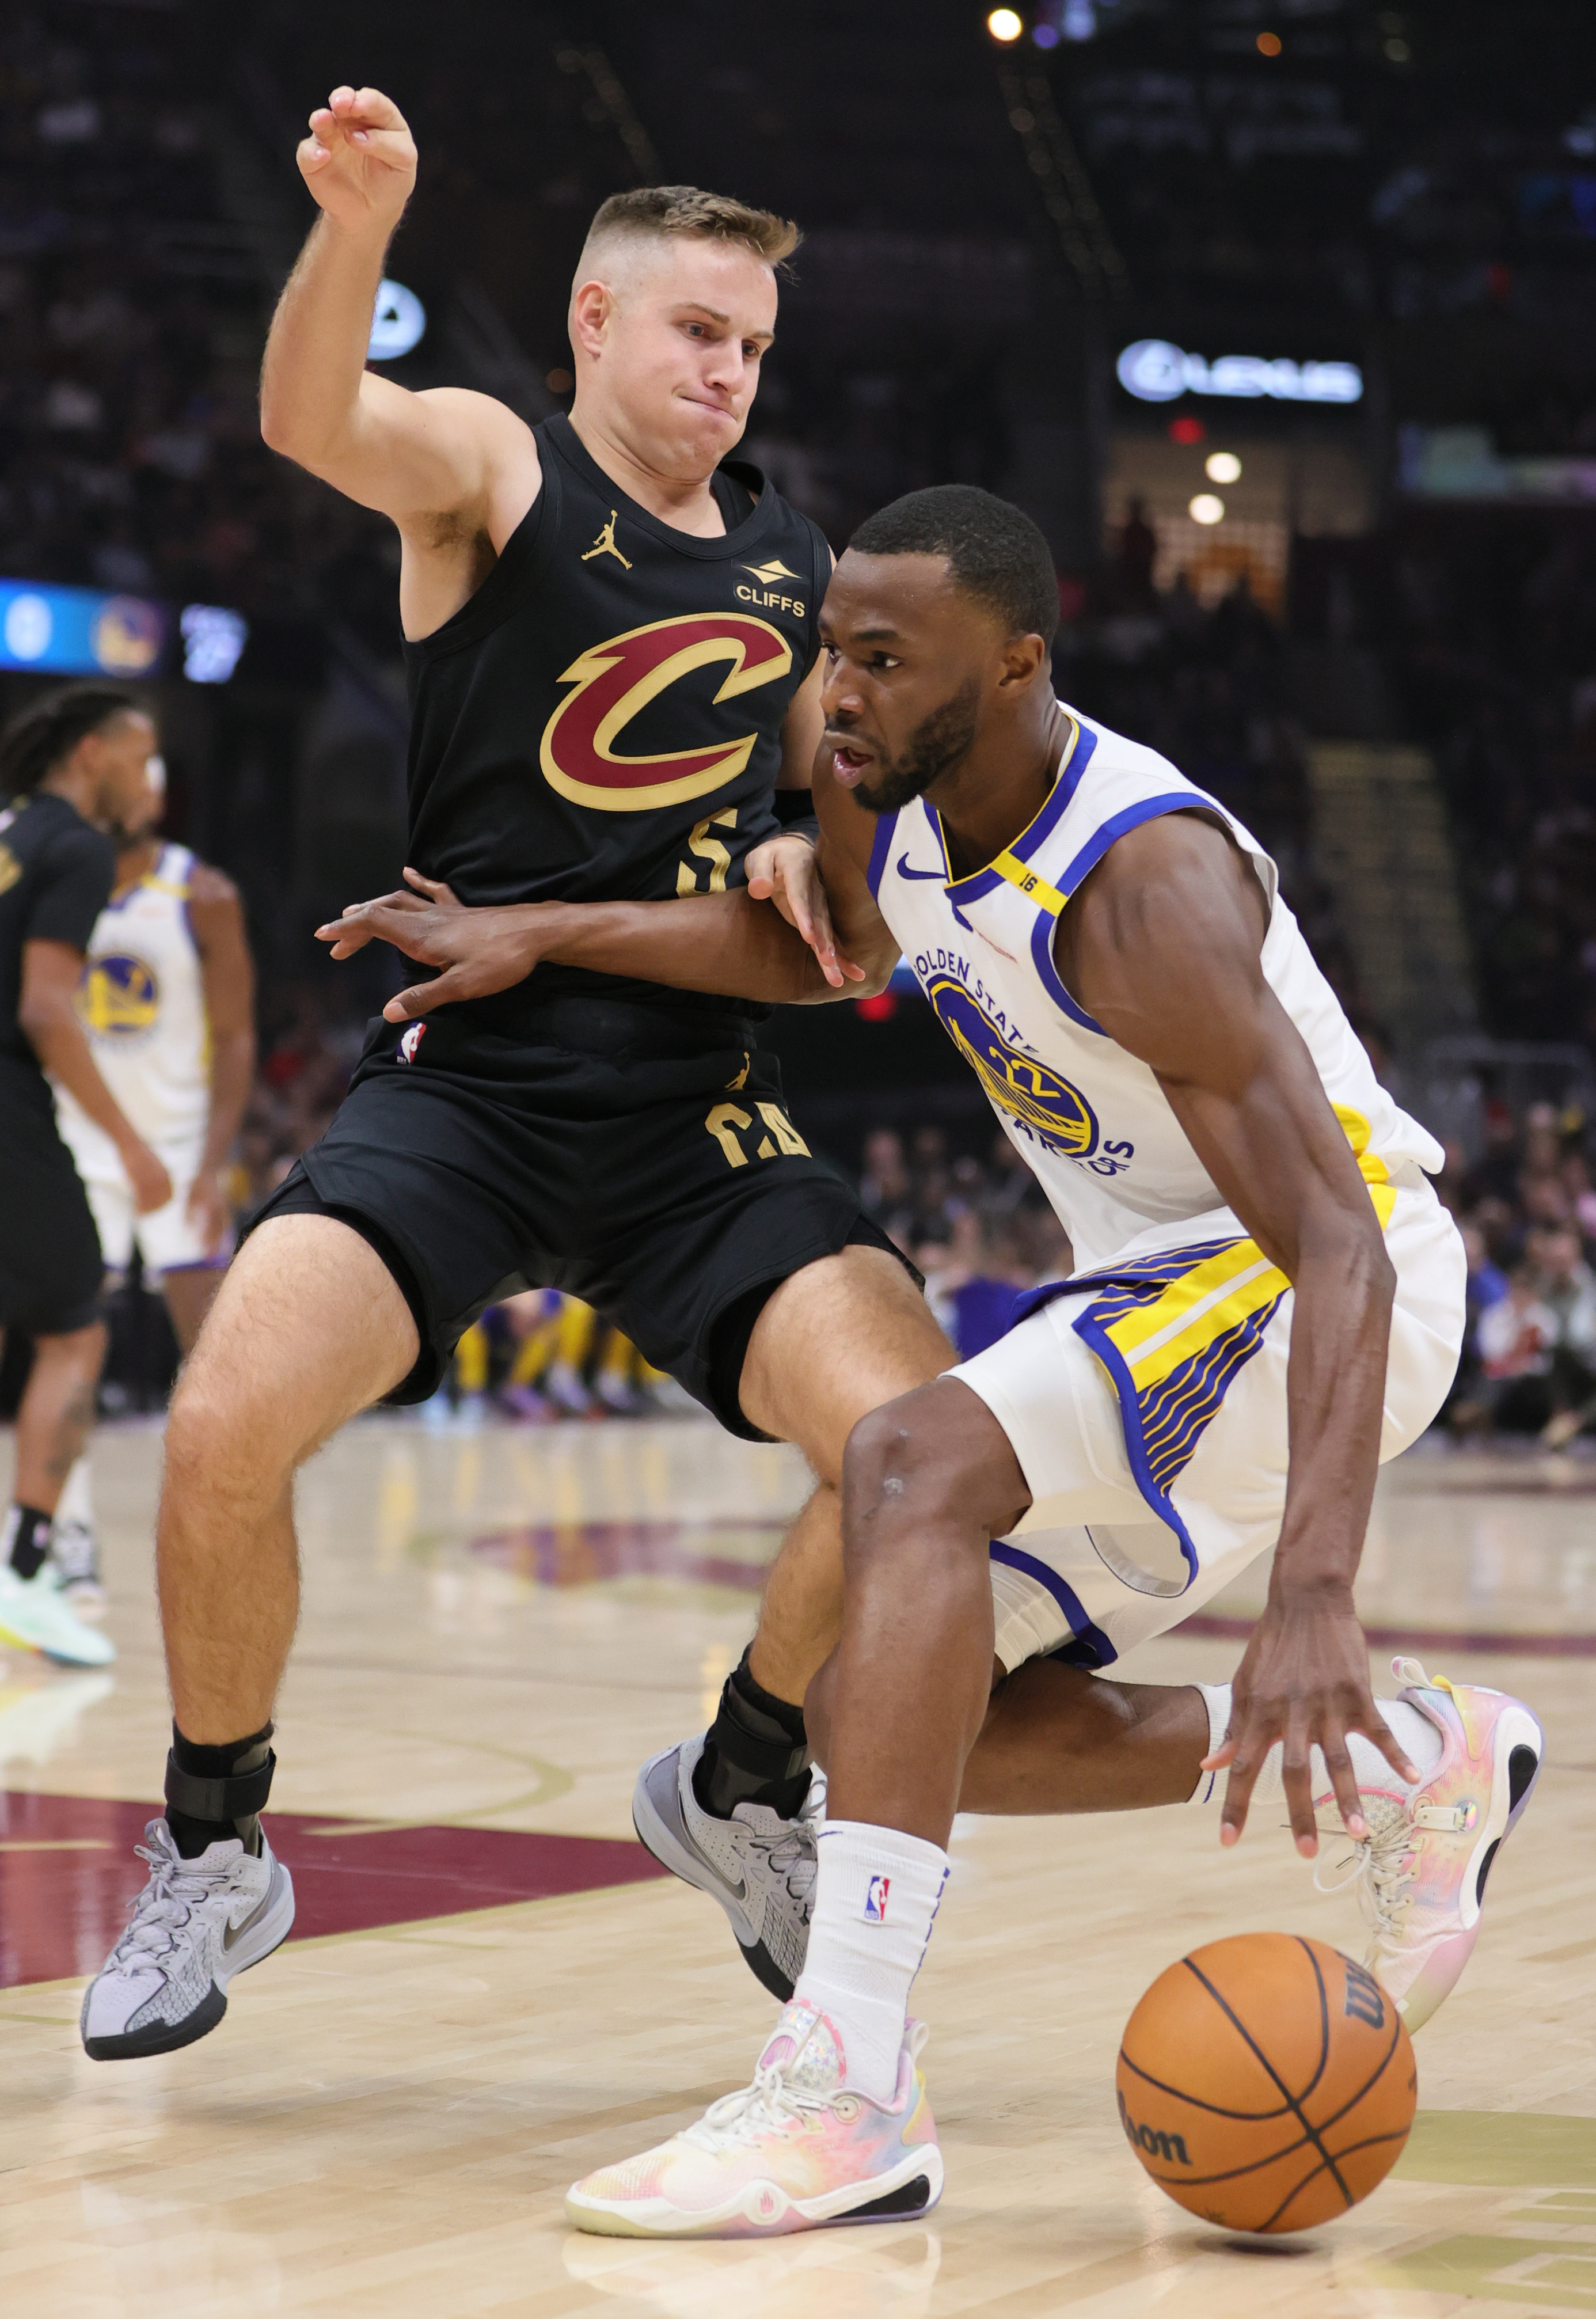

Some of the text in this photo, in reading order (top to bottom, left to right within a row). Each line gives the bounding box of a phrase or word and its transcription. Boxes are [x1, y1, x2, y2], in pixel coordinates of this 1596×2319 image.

[736, 585, 805, 618] CLIFFS
[539, 612, 793, 813] C
[675, 806, 738, 899] 5
[1019, 872, 1038, 892] 16
[914, 948, 971, 983] OLDEN
[989, 1046, 1061, 1098] 22
